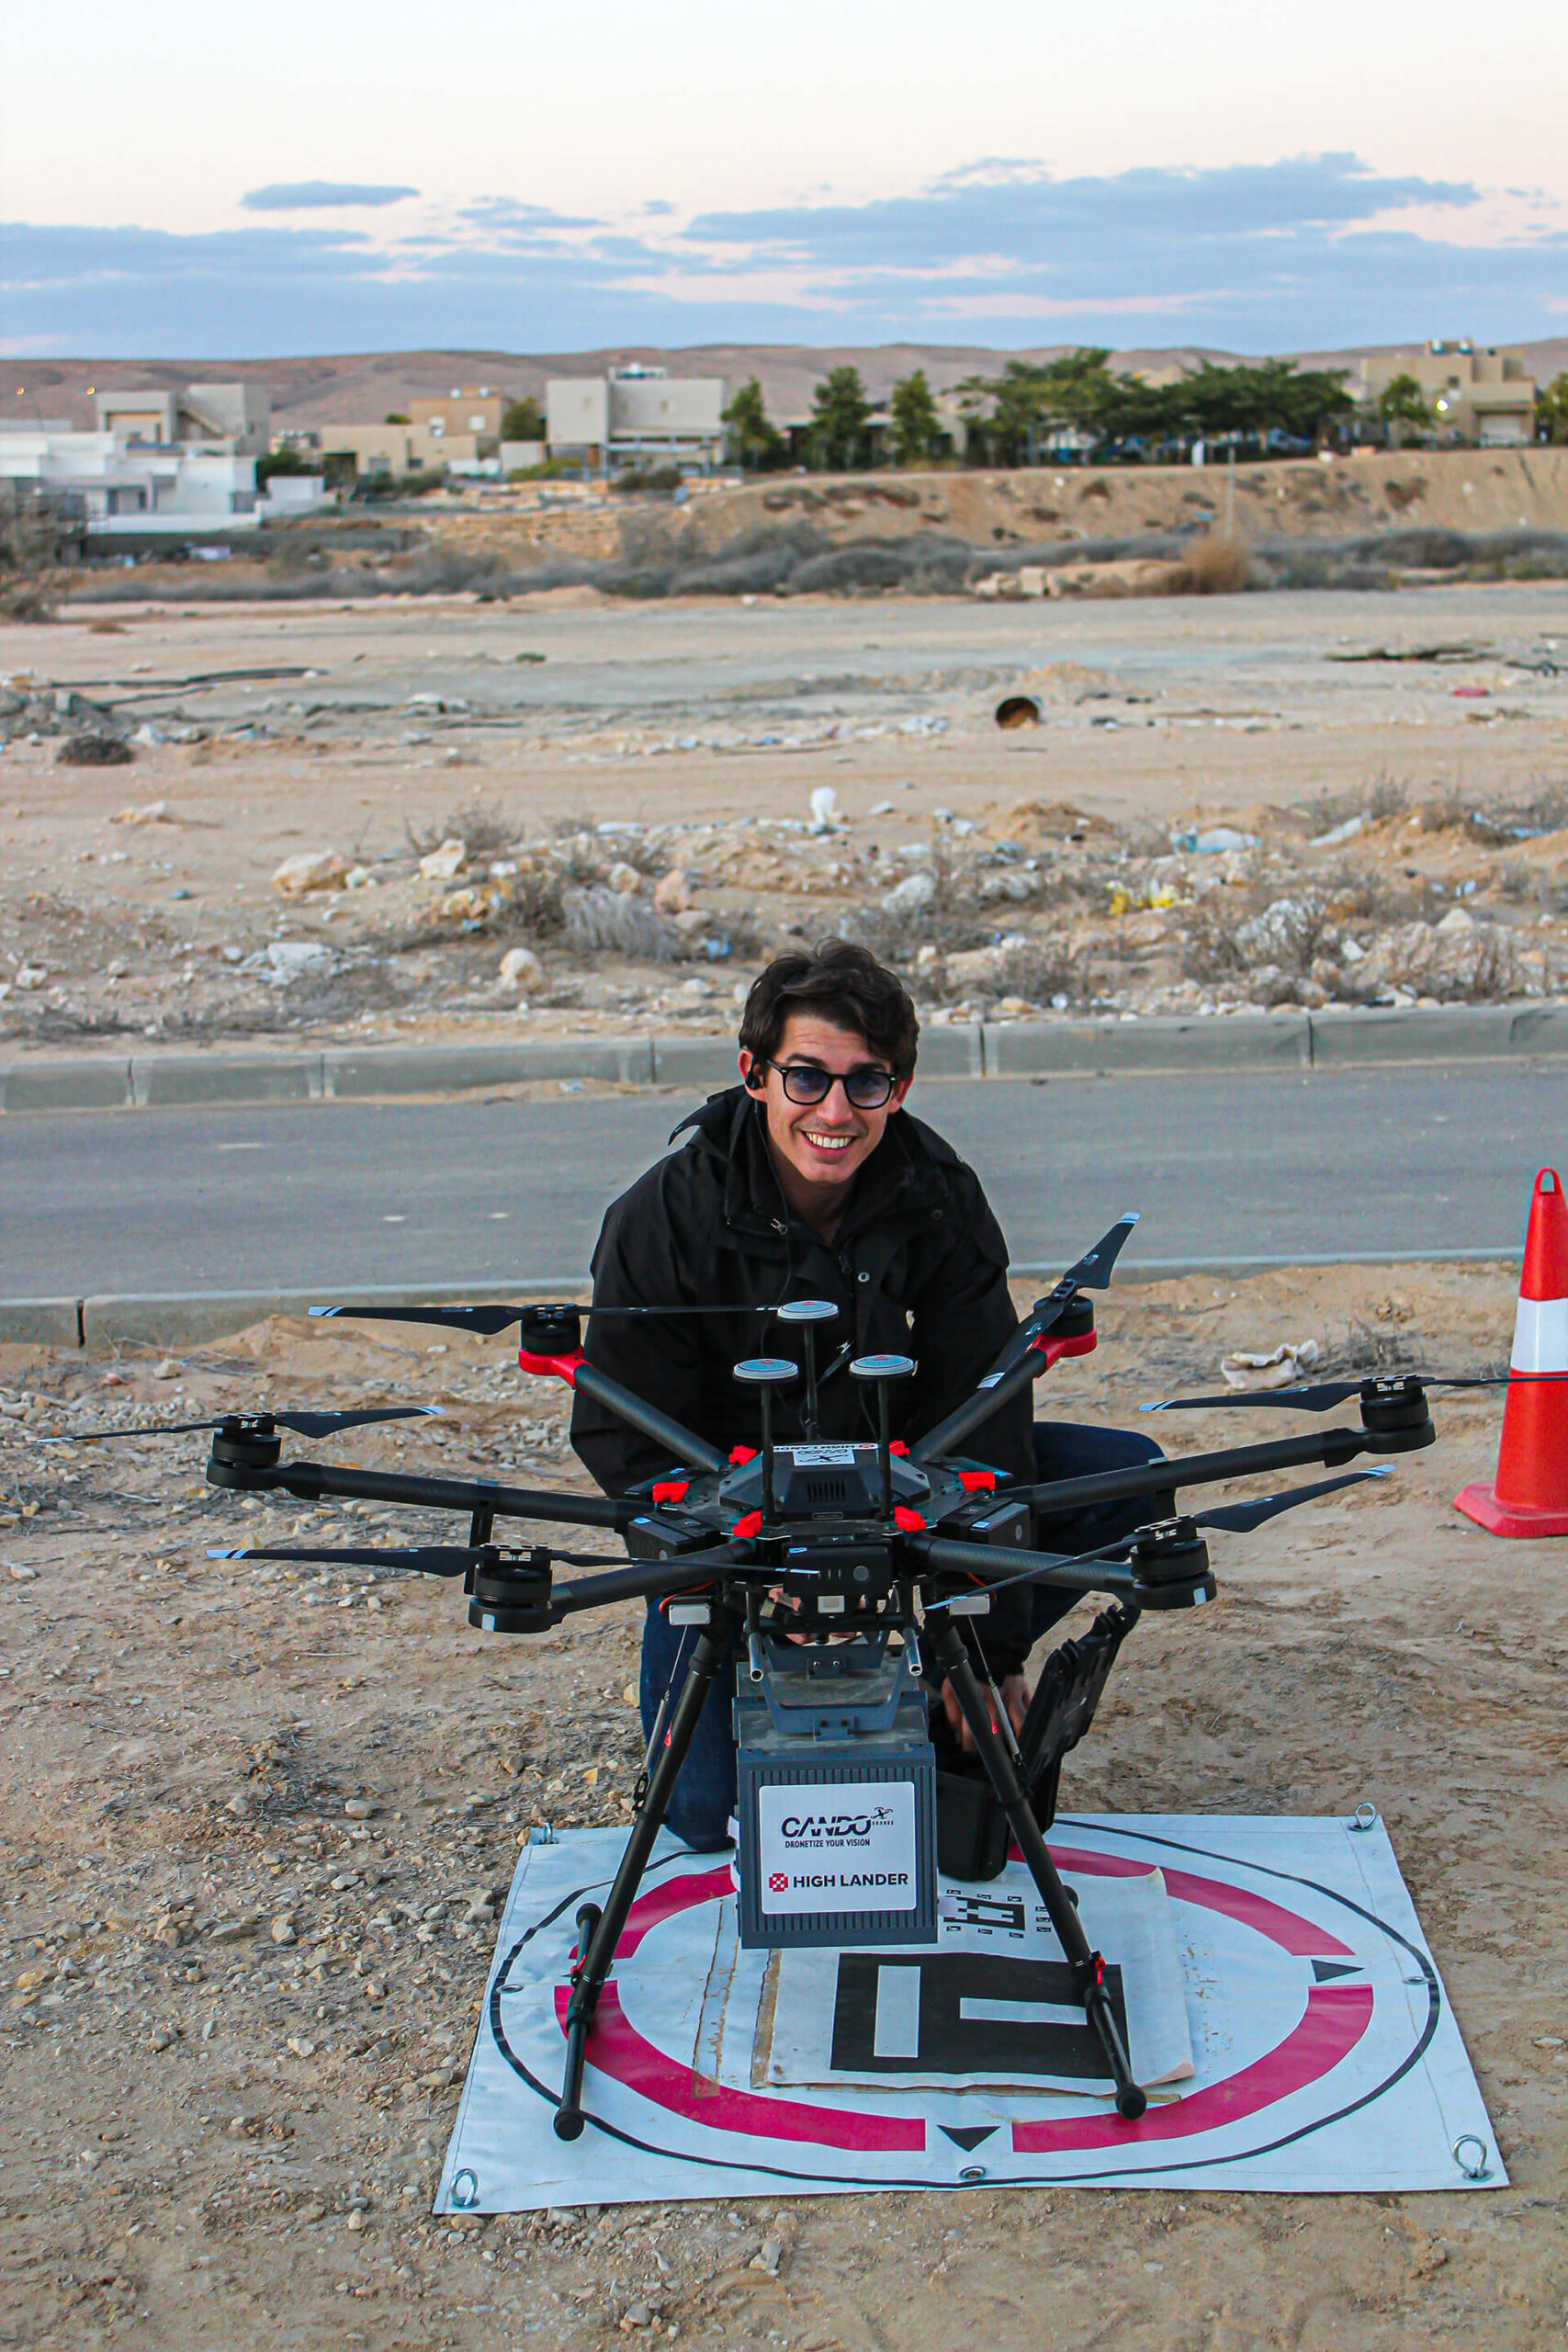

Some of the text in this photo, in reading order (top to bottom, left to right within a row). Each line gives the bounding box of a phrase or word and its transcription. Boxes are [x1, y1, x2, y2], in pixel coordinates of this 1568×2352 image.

[781, 1815, 872, 1838] CANDO
[784, 1838, 871, 1849] DRONETIZE YOUR VISION
[793, 1872, 908, 1888] HIGH LANDER
